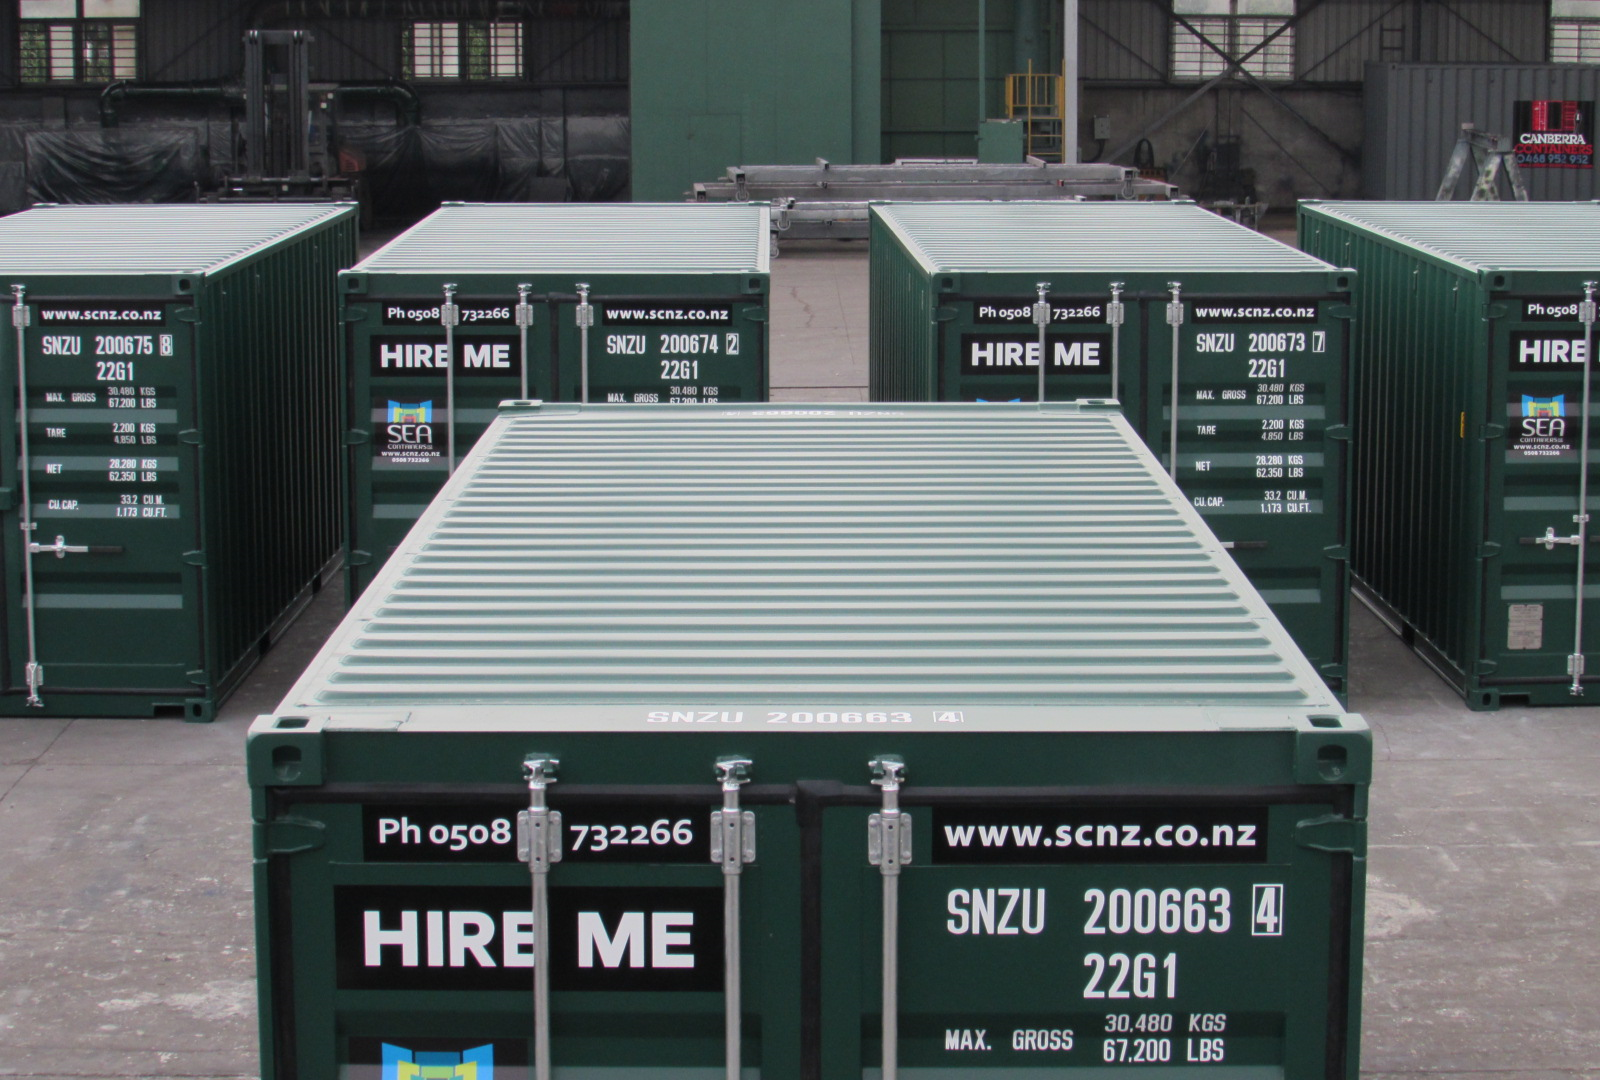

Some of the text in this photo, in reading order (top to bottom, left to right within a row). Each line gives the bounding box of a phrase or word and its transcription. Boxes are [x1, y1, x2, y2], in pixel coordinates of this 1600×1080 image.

[1520, 133, 1586, 144] CANBERRA
[1515, 144, 1593, 154] CONTAINERS
[42, 310, 161, 320] www.scnz.co.nz
[388, 307, 510, 321] Ph 0508 732266
[607, 309, 729, 320] www.scnz.co.nz
[979, 306, 1100, 320] Ph 0508 732266
[1195, 308, 1315, 318] www.scnz.co.nz
[1528, 304, 1578, 318] Ph 0508
[42, 336, 171, 355] SNZU 200675 8
[606, 334, 738, 354] SNZU 200674 2
[1196, 334, 1234, 352] SNZU
[1248, 333, 1305, 352] 200673
[380, 344, 510, 368] HIRE ME
[972, 343, 1100, 366] HIRE ME
[1519, 340, 1585, 363] HIRE
[96, 362, 134, 381] 22G1
[660, 360, 698, 379] 22G1
[1248, 359, 1285, 378] 22G1
[140, 387, 156, 395] KGS
[703, 387, 718, 395] KGS
[1289, 384, 1305, 392] KGS
[72, 393, 96, 402] GROSS
[607, 393, 659, 403] MAX. GROSS
[1196, 391, 1246, 400] MAX. GROSS
[1288, 395, 1304, 404] LBS
[141, 398, 157, 408] LBS
[140, 423, 156, 433] KGS
[1289, 419, 1304, 429] KGS
[1521, 418, 1565, 437] SEA
[46, 428, 66, 437] TARE
[387, 424, 432, 443] SEA
[1197, 425, 1216, 435] TARE
[141, 435, 157, 444] LBS
[1288, 432, 1304, 441] LBS
[141, 459, 157, 468] KGS
[1288, 455, 1304, 465] KGS
[47, 464, 62, 473] NET
[1196, 461, 1211, 471] NET
[141, 472, 157, 481] LBS
[1288, 468, 1304, 478] LBS
[647, 711, 743, 723] SNZU
[767, 712, 912, 723] 200663
[379, 818, 693, 852] Ph 0508 732266
[944, 824, 1256, 847] www.scnz.co.nz
[947, 886, 1279, 934] SNZU 200663 4
[364, 910, 695, 968] HIRE ME
[1083, 952, 1177, 998] 22G1
[1188, 1013, 1227, 1032] KGS
[945, 1029, 1074, 1051] MAX. GROSS
[1187, 1038, 1224, 1062] LBS
